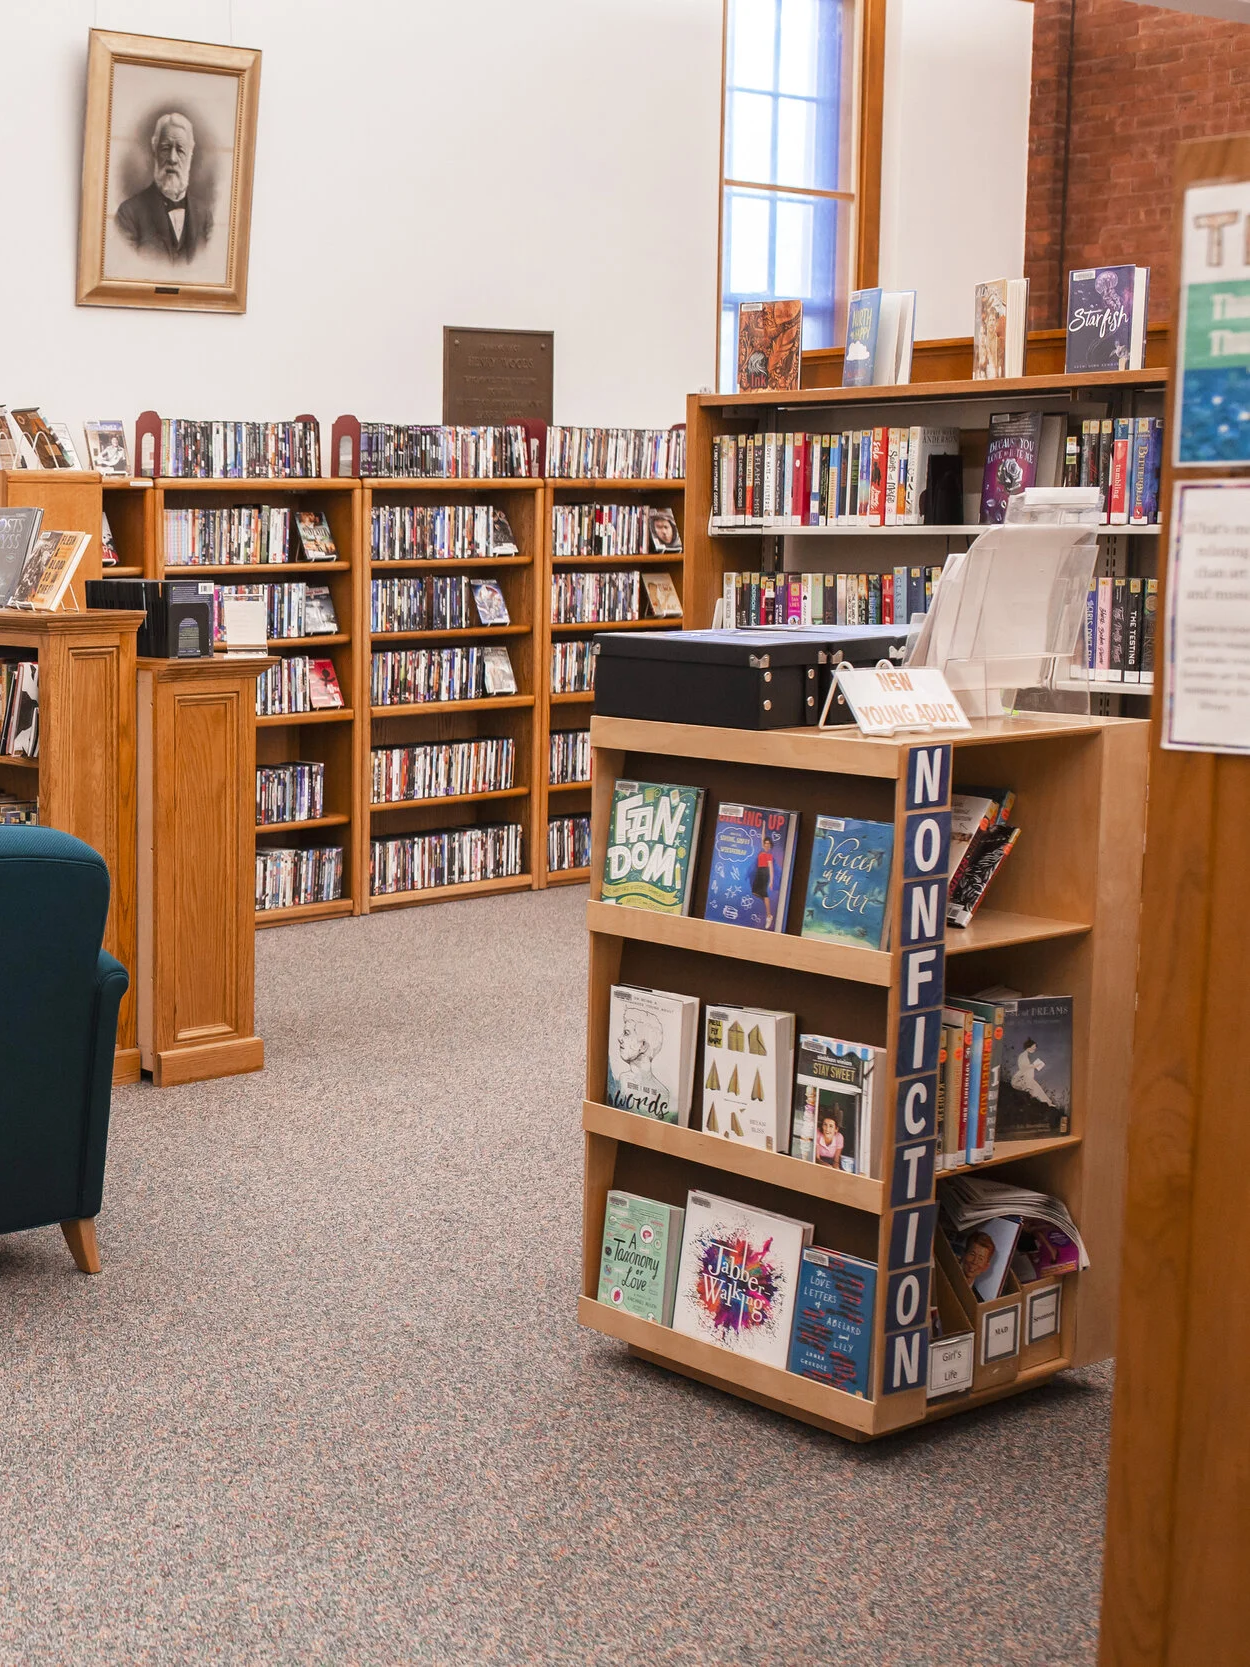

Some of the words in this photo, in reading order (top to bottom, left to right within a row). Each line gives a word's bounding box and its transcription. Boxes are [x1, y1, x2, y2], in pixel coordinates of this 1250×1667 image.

[852, 307, 872, 329] NORTH
[1069, 305, 1129, 338] Starfish
[751, 374, 767, 388] Ink
[872, 441, 884, 460] solo
[989, 437, 1016, 453] BECAUS
[1019, 437, 1035, 451] YOU
[887, 449, 898, 473] Saints
[987, 450, 1003, 464] LOVE
[1009, 448, 1024, 458] HTE
[1025, 453, 1034, 464] ME
[1113, 464, 1122, 499] tumbling
[886, 482, 896, 504] Misfits
[48, 559, 66, 570] BLOOD
[1130, 610, 1138, 628] THE
[1128, 630, 1137, 665] TESTING
[875, 672, 914, 692] NEW
[857, 703, 914, 727] YOUNG
[914, 703, 961, 723] ADULT
[768, 813, 785, 831] UP
[607, 841, 677, 887] DOM
[823, 835, 877, 873] Voices
[822, 869, 833, 881] in
[834, 868, 853, 886] the
[821, 881, 869, 915] Air
[1031, 1005, 1069, 1017] DREAMS
[813, 1063, 829, 1077] STAY
[830, 1066, 856, 1082] SWEET
[892, 747, 943, 1389] NONFICTION
[982, 1052, 991, 1088] NGER
[962, 1062, 970, 1105] NOTORIOUS
[614, 1090, 670, 1120] words
[937, 1083, 946, 1122] KAREEM
[979, 1093, 989, 1115] KID
[628, 1232, 637, 1250] A
[613, 1237, 660, 1280] Taxonomy
[621, 1266, 647, 1292] Love
[810, 1275, 831, 1289] LOVE
[702, 1272, 766, 1331] Walking
[803, 1286, 837, 1304] LETTERS
[826, 1317, 862, 1336] ABELARD
[994, 1326, 1009, 1335] MAD
[833, 1341, 854, 1354] LILY
[942, 1350, 962, 1362] Girl's
[944, 1369, 958, 1381] Life
